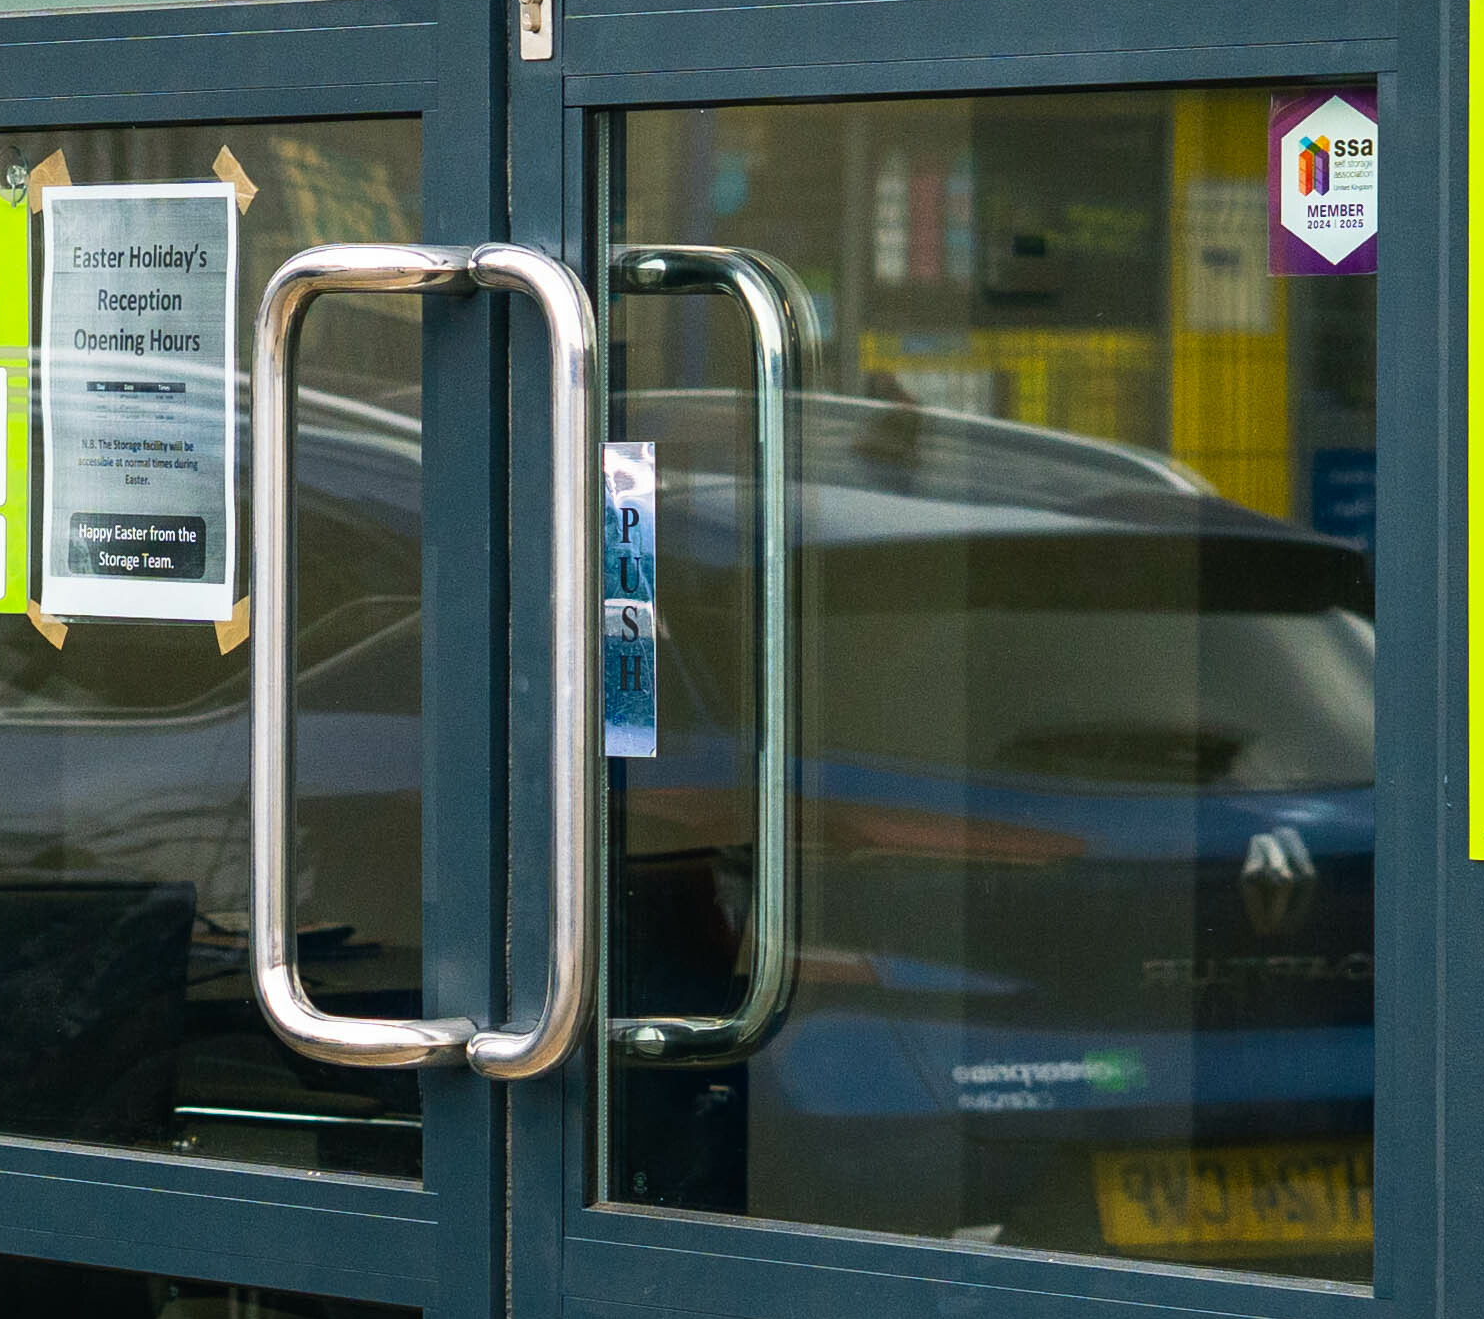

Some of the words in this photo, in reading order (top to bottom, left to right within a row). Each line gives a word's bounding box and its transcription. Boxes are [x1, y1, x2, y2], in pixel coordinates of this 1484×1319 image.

[1334, 139, 1373, 157] ssa
[1307, 204, 1364, 217] MEMBER
[1307, 220, 1331, 229] 2024
[1340, 219, 1364, 228] 2025
[73, 247, 125, 268] Easter
[98, 288, 182, 316] Reception
[74, 328, 145, 356] Opening
[150, 329, 200, 352] Hours
[98, 439, 112, 449] The
[113, 439, 142, 453] Storage
[143, 440, 168, 452] facility
[169, 441, 182, 451] will
[184, 441, 194, 451] be
[78, 456, 113, 467] accessible
[115, 458, 123, 467] at
[124, 457, 151, 468] normal
[152, 458, 173, 468] times
[174, 458, 198, 471] during
[125, 475, 151, 485] Easter.
[78, 524, 112, 542] Happy
[115, 525, 147, 540] Easter
[149, 525, 175, 542] from
[178, 527, 197, 543] the
[99, 552, 139, 570] Storage
[142, 553, 174, 569] Team.
[619, 507, 641, 691] PUSH
